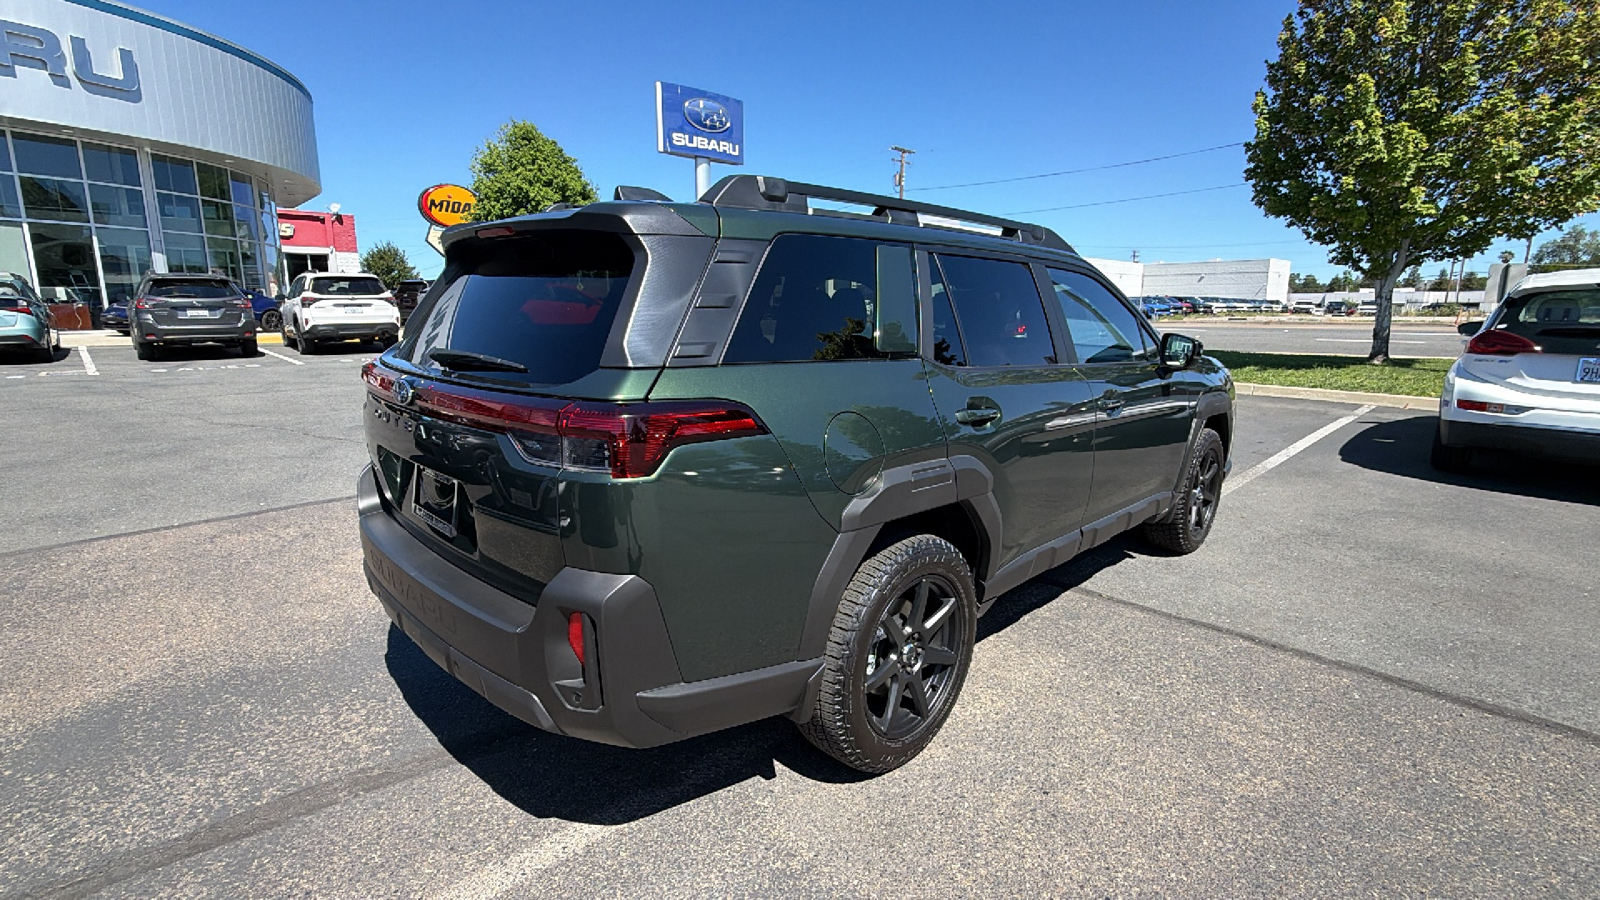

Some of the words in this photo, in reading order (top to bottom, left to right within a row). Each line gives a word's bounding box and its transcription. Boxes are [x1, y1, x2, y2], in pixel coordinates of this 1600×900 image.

[672, 132, 739, 156] SUBARU
[428, 198, 472, 214] MIDA
[374, 408, 461, 451] OUTBACK
[370, 549, 458, 634] SUBARU
